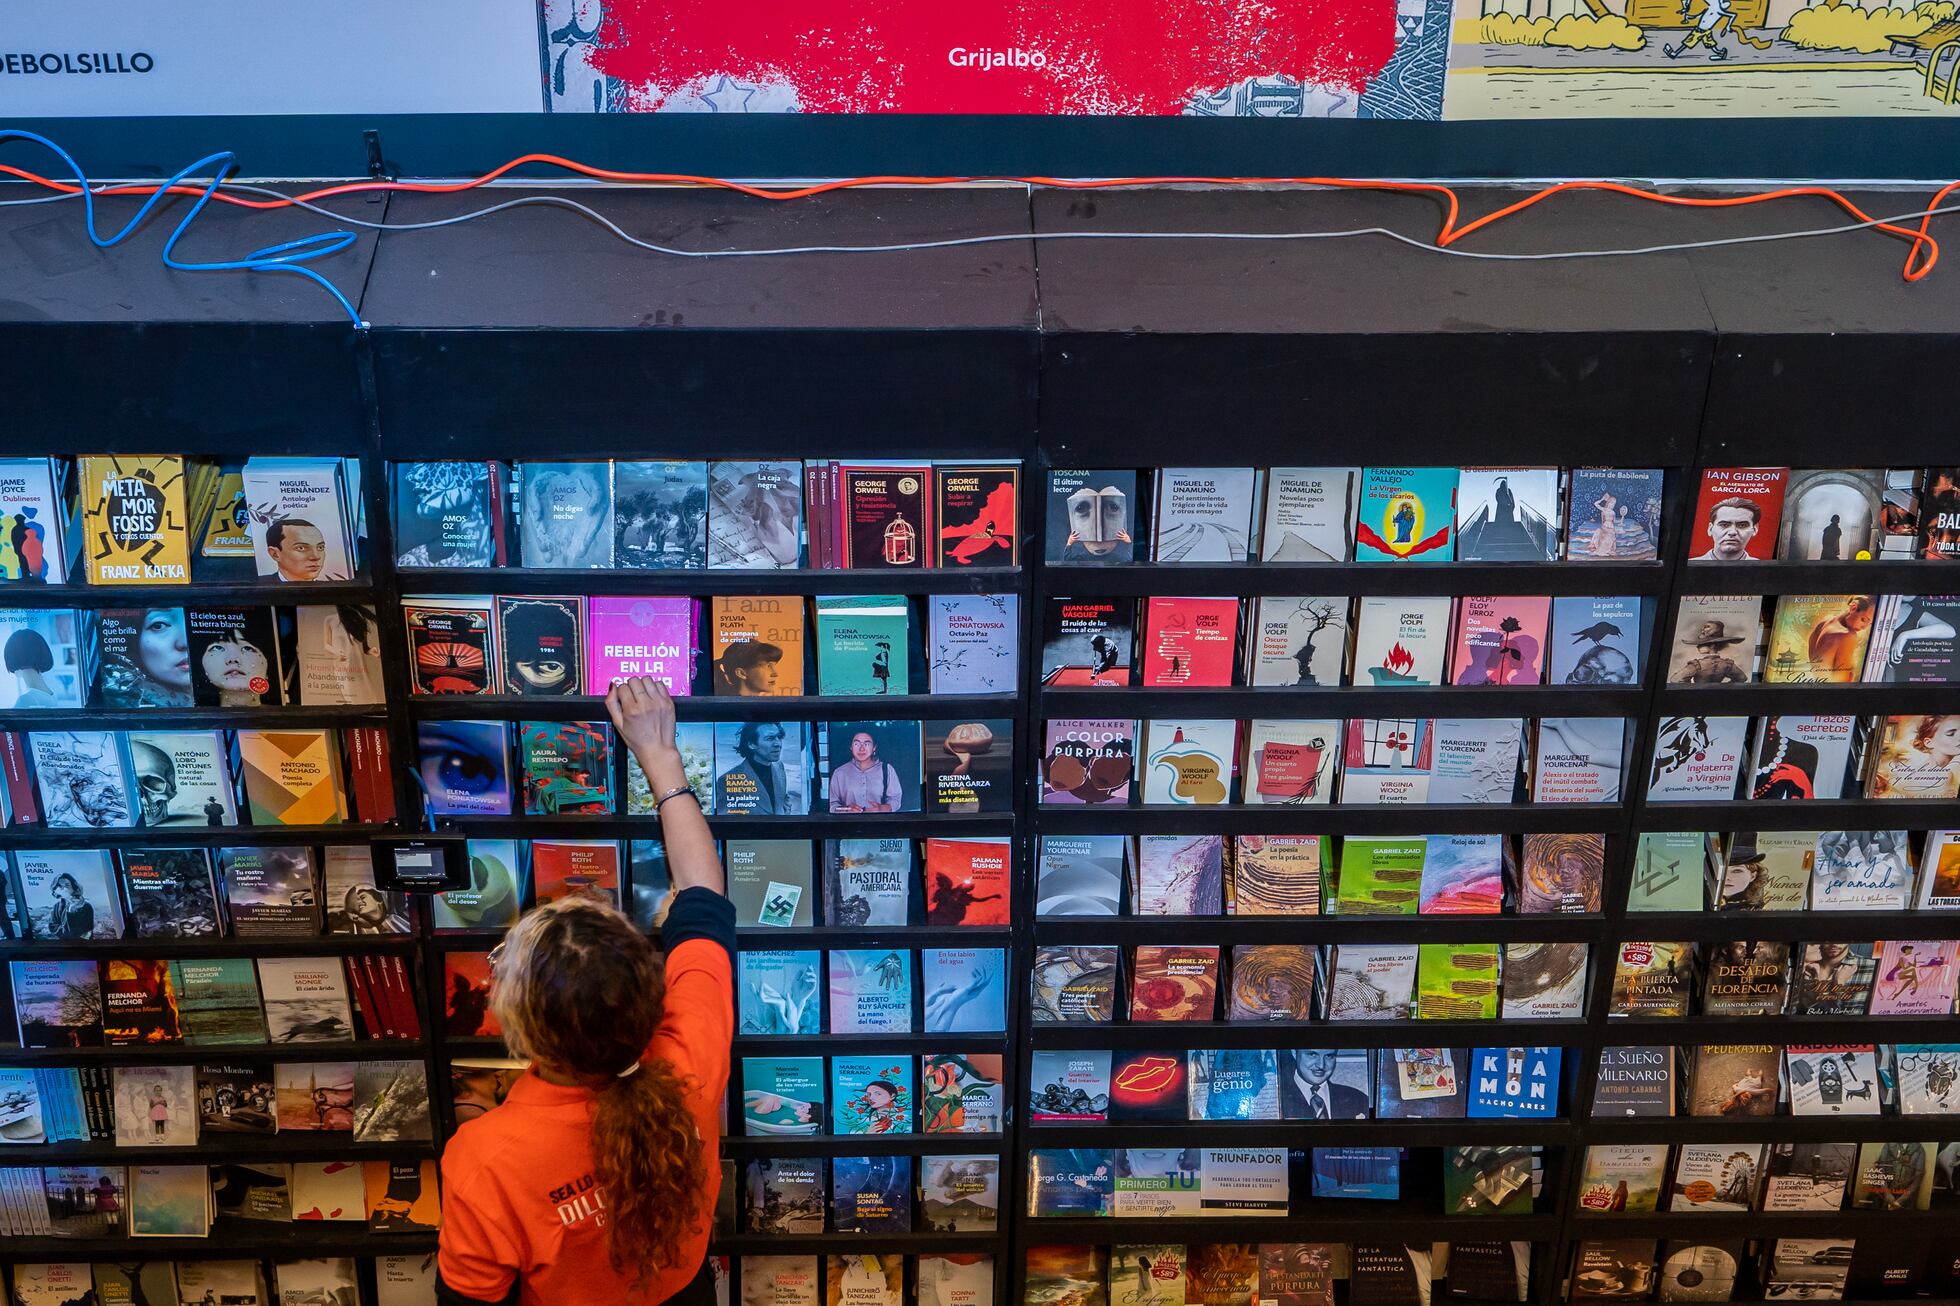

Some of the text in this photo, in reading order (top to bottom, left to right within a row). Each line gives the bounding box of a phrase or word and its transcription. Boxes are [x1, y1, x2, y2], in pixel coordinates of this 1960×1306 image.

[0, 52, 153, 73] EBOLS!LLO
[949, 48, 1046, 71] Grijalbo
[107, 471, 116, 479] LA
[1707, 471, 1728, 480] IAN
[1, 478, 25, 486] JAMES
[1, 486, 25, 494] JOYCE
[102, 479, 146, 497] META
[281, 486, 330, 494] HERNÁNDEZ
[282, 496, 315, 504] Antología
[122, 499, 156, 514] MOR
[113, 515, 154, 532] FOSIS
[101, 564, 185, 579] FRANZ KAFKA
[102, 619, 119, 628] Algo
[102, 628, 117, 636] que
[605, 642, 679, 657] REBELIÓN
[621, 662, 663, 672] EN LA
[1797, 724, 1848, 733] secretos
[1067, 732, 1124, 742] COLOR
[1056, 745, 1123, 758] PÚRPURA
[1687, 765, 1733, 773] Inglaterra
[1696, 774, 1730, 782] Virginia
[1819, 850, 1860, 870] Amar
[850, 873, 902, 884] PASTORAL
[861, 883, 901, 892] AMERICANA
[1719, 964, 1777, 976] DESAFÍO
[1622, 976, 1678, 984] LA PUERTA
[1627, 986, 1673, 994] PINTADA
[1712, 984, 1778, 994] FLORENCIA
[873, 1002, 906, 1010] SÁNCHEZ
[1601, 1051, 1663, 1064] EL SUEÑO
[1214, 1070, 1250, 1080] Lugares
[1598, 1068, 1667, 1080] MILENARIO
[1214, 1078, 1252, 1093] genio
[1480, 1099, 1513, 1107] NACHO
[1211, 1152, 1281, 1165] TRIUNFADOR
[1069, 1173, 1107, 1182] Castañeda
[1120, 1171, 1195, 1189] PRIMERO TU
[549, 1174, 593, 1204] SEA LO
